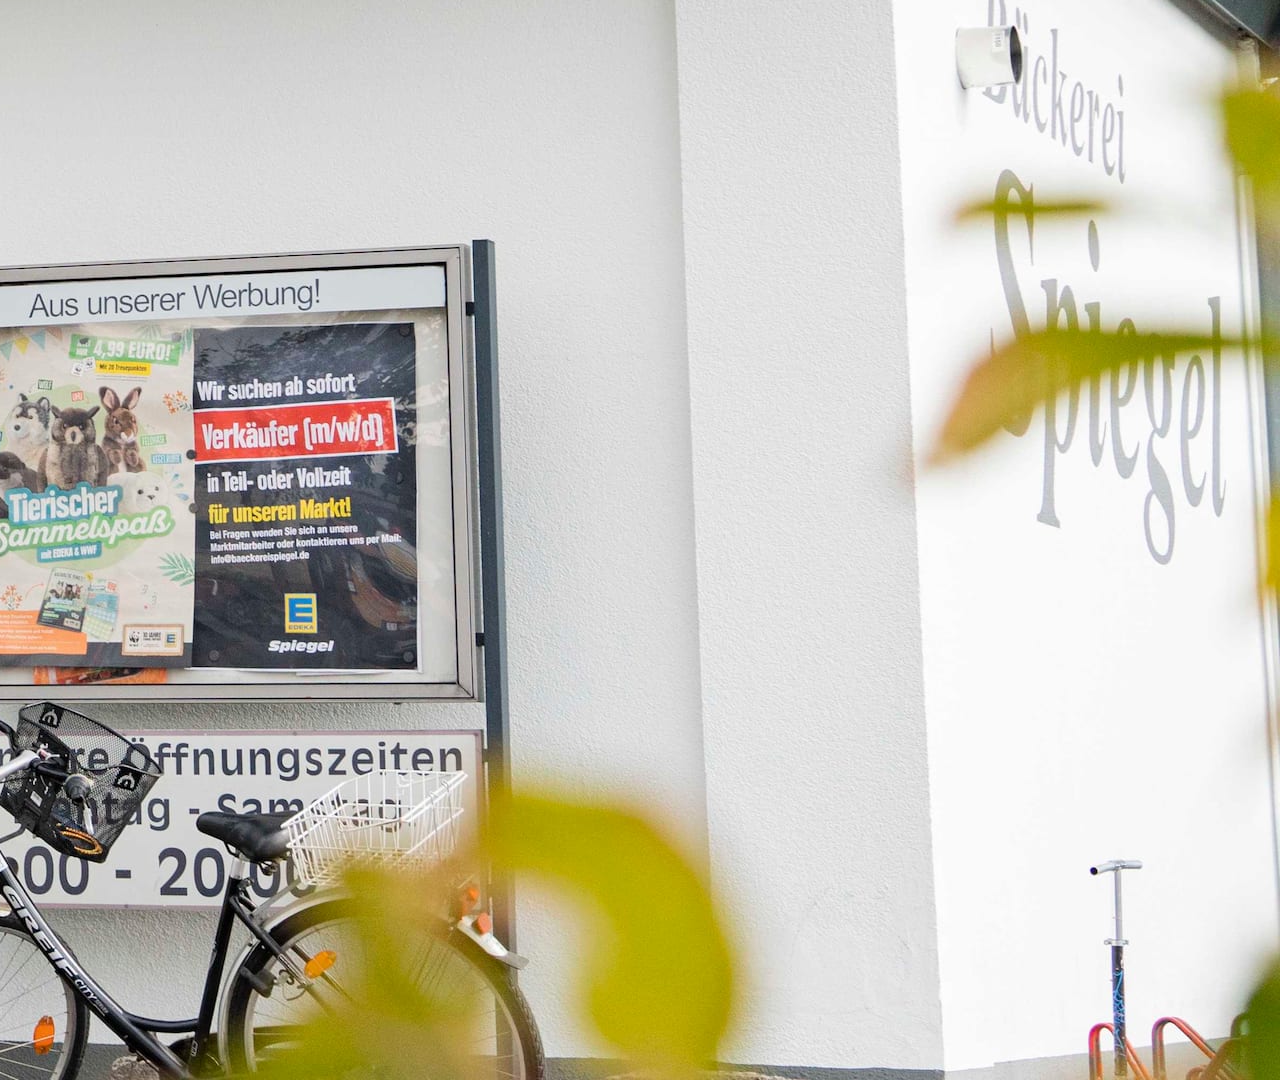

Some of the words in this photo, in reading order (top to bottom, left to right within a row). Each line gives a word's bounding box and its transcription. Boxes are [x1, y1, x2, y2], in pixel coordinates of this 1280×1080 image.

[28, 293, 79, 318] Aus
[88, 292, 186, 316] unserer
[192, 278, 321, 311] Werbung!
[93, 340, 125, 358] 4,99
[988, 169, 1227, 565] Spiegel
[196, 381, 225, 401] Wir
[228, 379, 282, 400] suchen
[285, 376, 303, 396] ab
[306, 373, 356, 395] sofort
[202, 421, 298, 450] Verkäufer
[303, 413, 384, 451] (m/w/d)
[207, 473, 219, 493] in
[221, 470, 254, 493] Teil-
[257, 469, 294, 490] oder
[296, 466, 351, 489] Vollzeit
[9, 485, 118, 522] Tierischer
[208, 504, 230, 524] für
[233, 503, 296, 523] unseren
[300, 497, 351, 520] Markt!
[209, 529, 222, 540] Bei
[222, 529, 250, 541] Fragen
[251, 528, 283, 538] wenden
[284, 526, 298, 536] Sie
[298, 525, 316, 535] sich
[316, 526, 328, 535] an
[328, 524, 358, 534] unsere
[210, 539, 275, 552] Marktmitarbeiter
[276, 538, 294, 548] oder
[295, 536, 348, 548] kontaktieren
[349, 536, 365, 545] uns
[366, 536, 379, 546] per
[381, 533, 402, 543] Mail:
[40, 549, 51, 560] mit
[52, 547, 73, 559] EDEKA
[74, 547, 80, 557] &
[80, 544, 98, 556] WWF
[210, 551, 310, 565] info@baeckereispiegel.de
[268, 640, 335, 653] Spiegel
[124, 737, 463, 781] Öffnungszeiten
[115, 869, 132, 879] -
[158, 847, 318, 897] 2000
[3, 885, 78, 978] GREIF
[75, 978, 97, 1003] CITY
